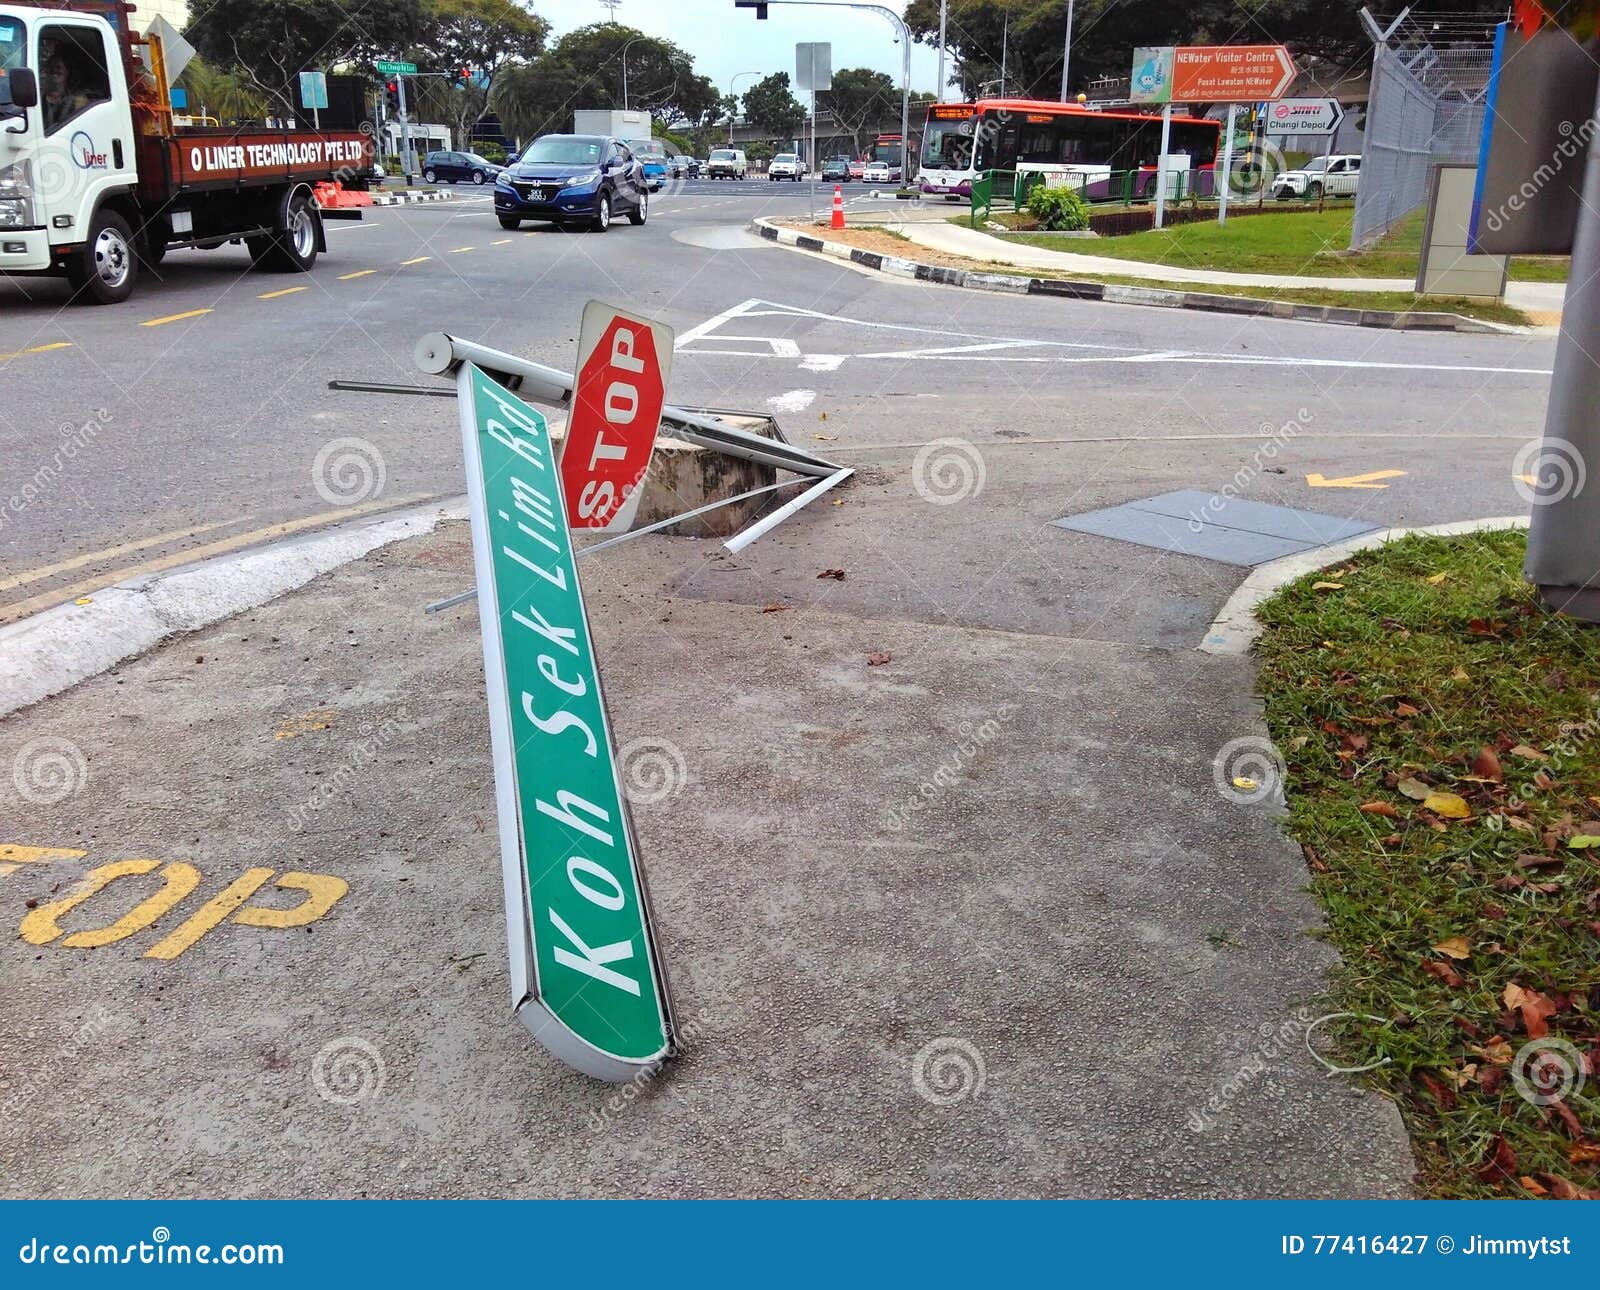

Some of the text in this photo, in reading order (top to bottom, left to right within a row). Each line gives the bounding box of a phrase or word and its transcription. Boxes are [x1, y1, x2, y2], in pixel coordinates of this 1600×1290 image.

[1177, 52, 1275, 63] NEWater Visitor Centre
[1269, 120, 1326, 130] Changi Depot
[190, 140, 363, 172] O LINER TECHNOLOGY PTE LTD
[578, 326, 645, 520] STOP
[482, 385, 642, 997] Koh Sek Lim Rd
